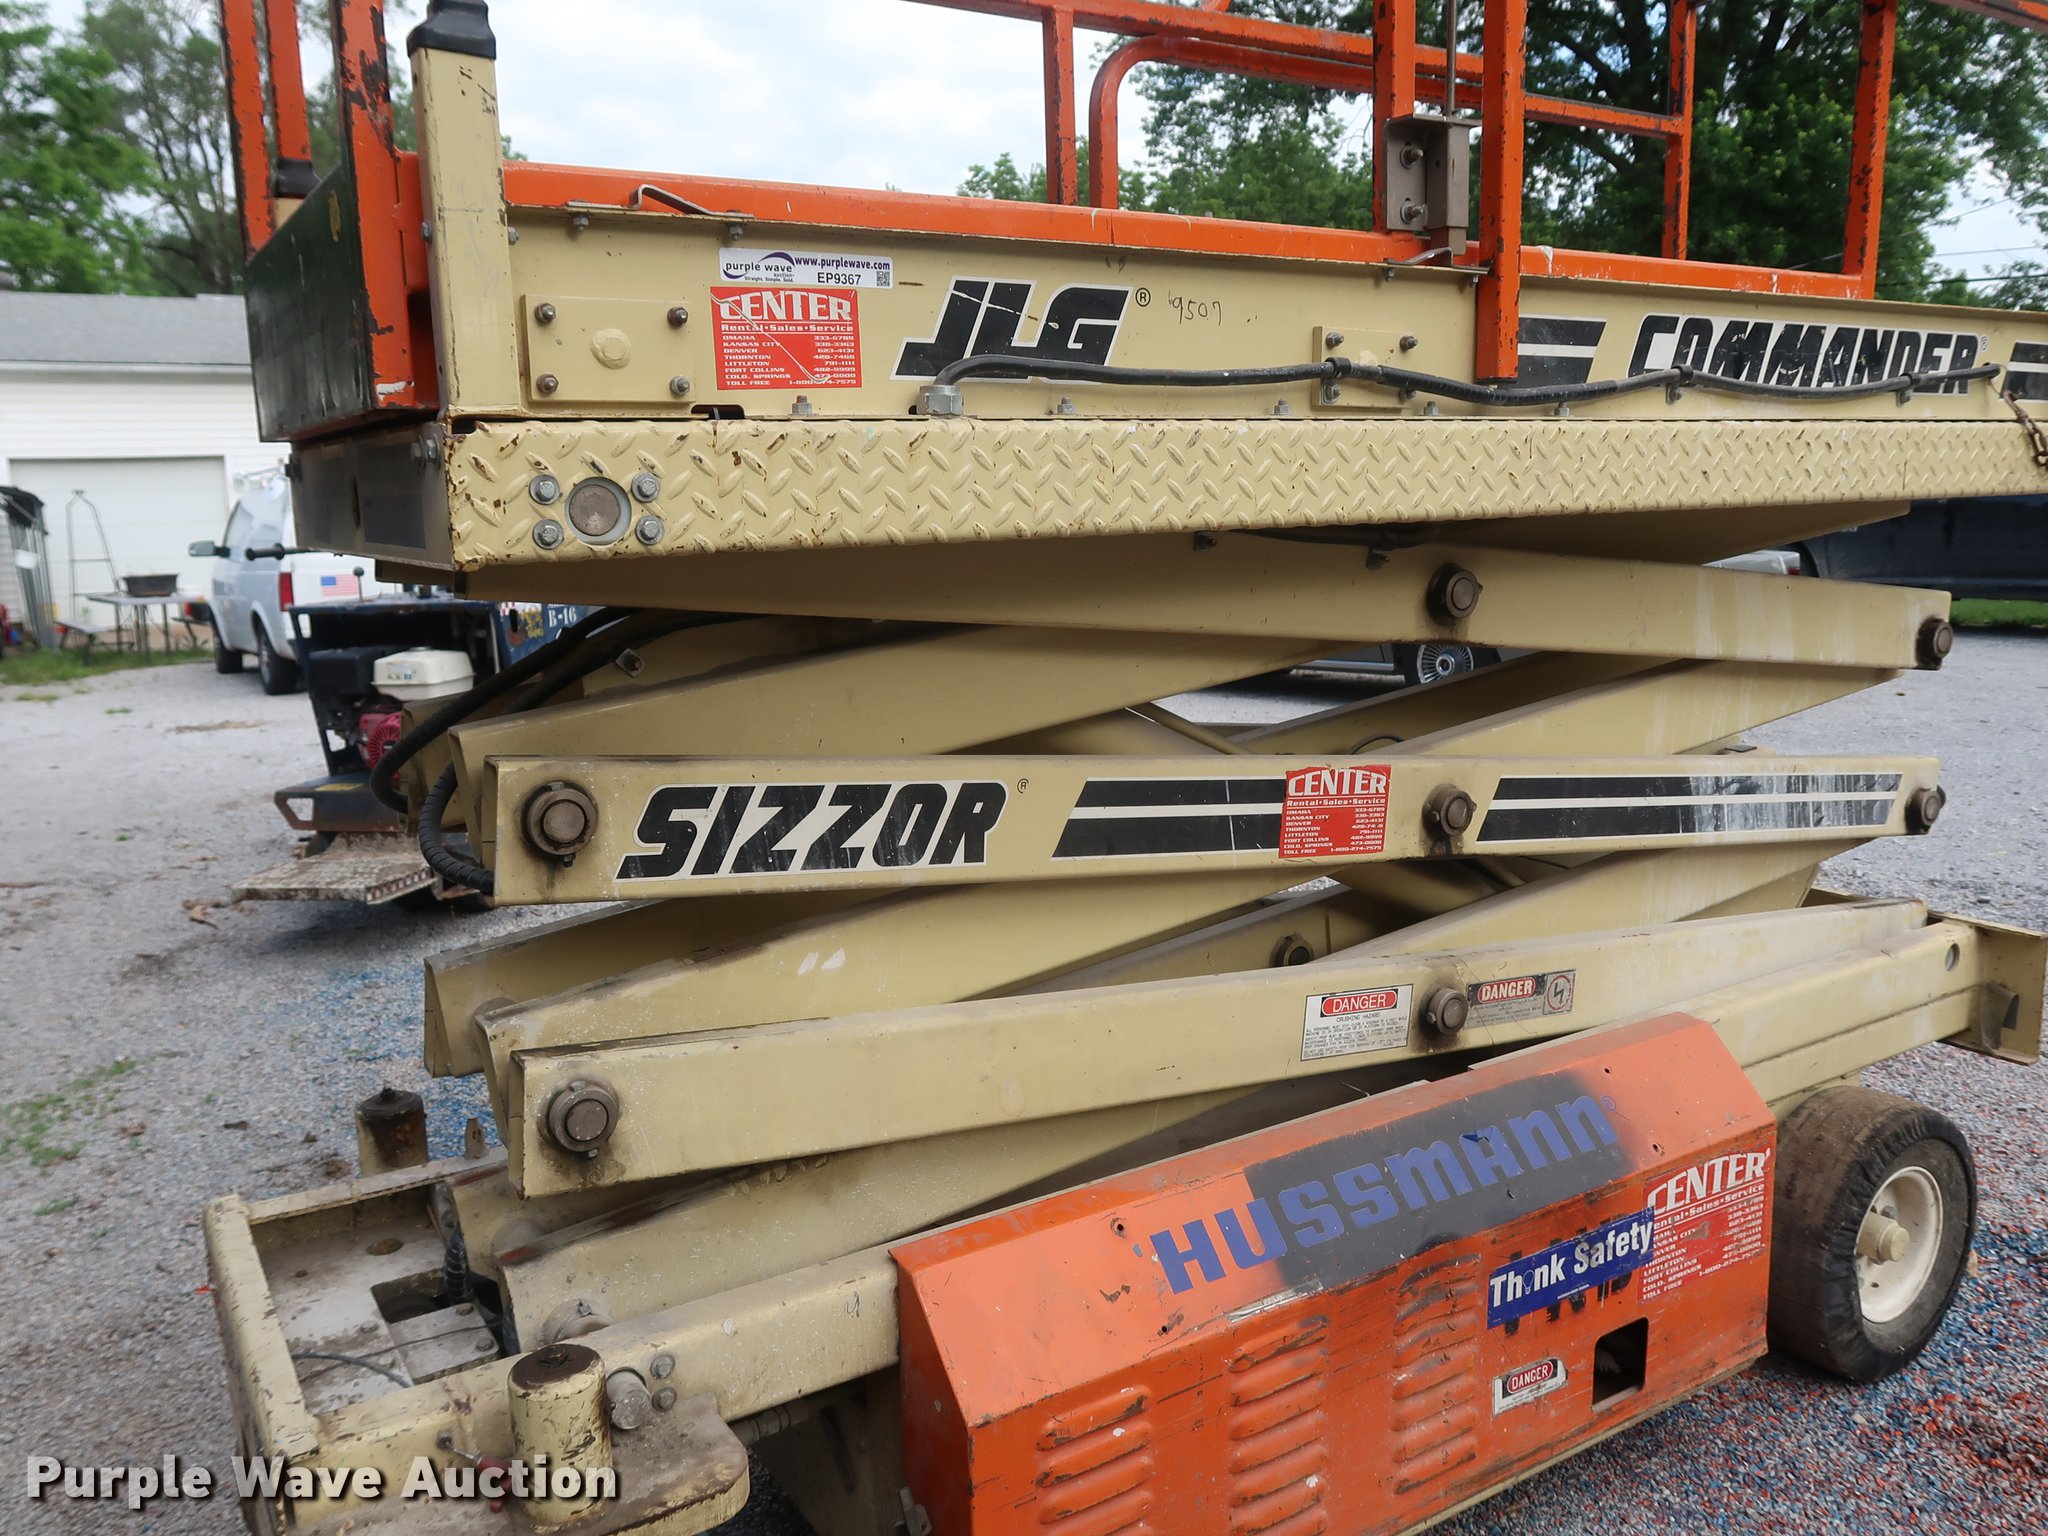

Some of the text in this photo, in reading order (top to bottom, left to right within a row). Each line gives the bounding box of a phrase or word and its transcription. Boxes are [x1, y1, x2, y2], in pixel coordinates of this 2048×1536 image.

[725, 262, 793, 273] purple wave
[794, 256, 891, 271] www.purplewave.com
[817, 271, 861, 286] EP9367
[720, 290, 852, 320] CENTER
[892, 277, 1132, 383] JLG
[1628, 314, 1980, 395] COMMANDER
[1288, 768, 1387, 796] CENTER
[1286, 797, 1386, 807] Rental Sales Service
[613, 781, 1007, 881] SIZZOR
[1332, 993, 1387, 1013] DANGER
[1481, 979, 1533, 1001] DANGER
[1647, 1152, 1765, 1215] CENTER
[1653, 1184, 1765, 1230] ental Sales Service
[1573, 1220, 1654, 1275] Safety
[1643, 1256, 1686, 1277] LITTLETON
[1665, 1258, 1698, 1275] COLLINS
[1511, 1364, 1549, 1390] DANGER
